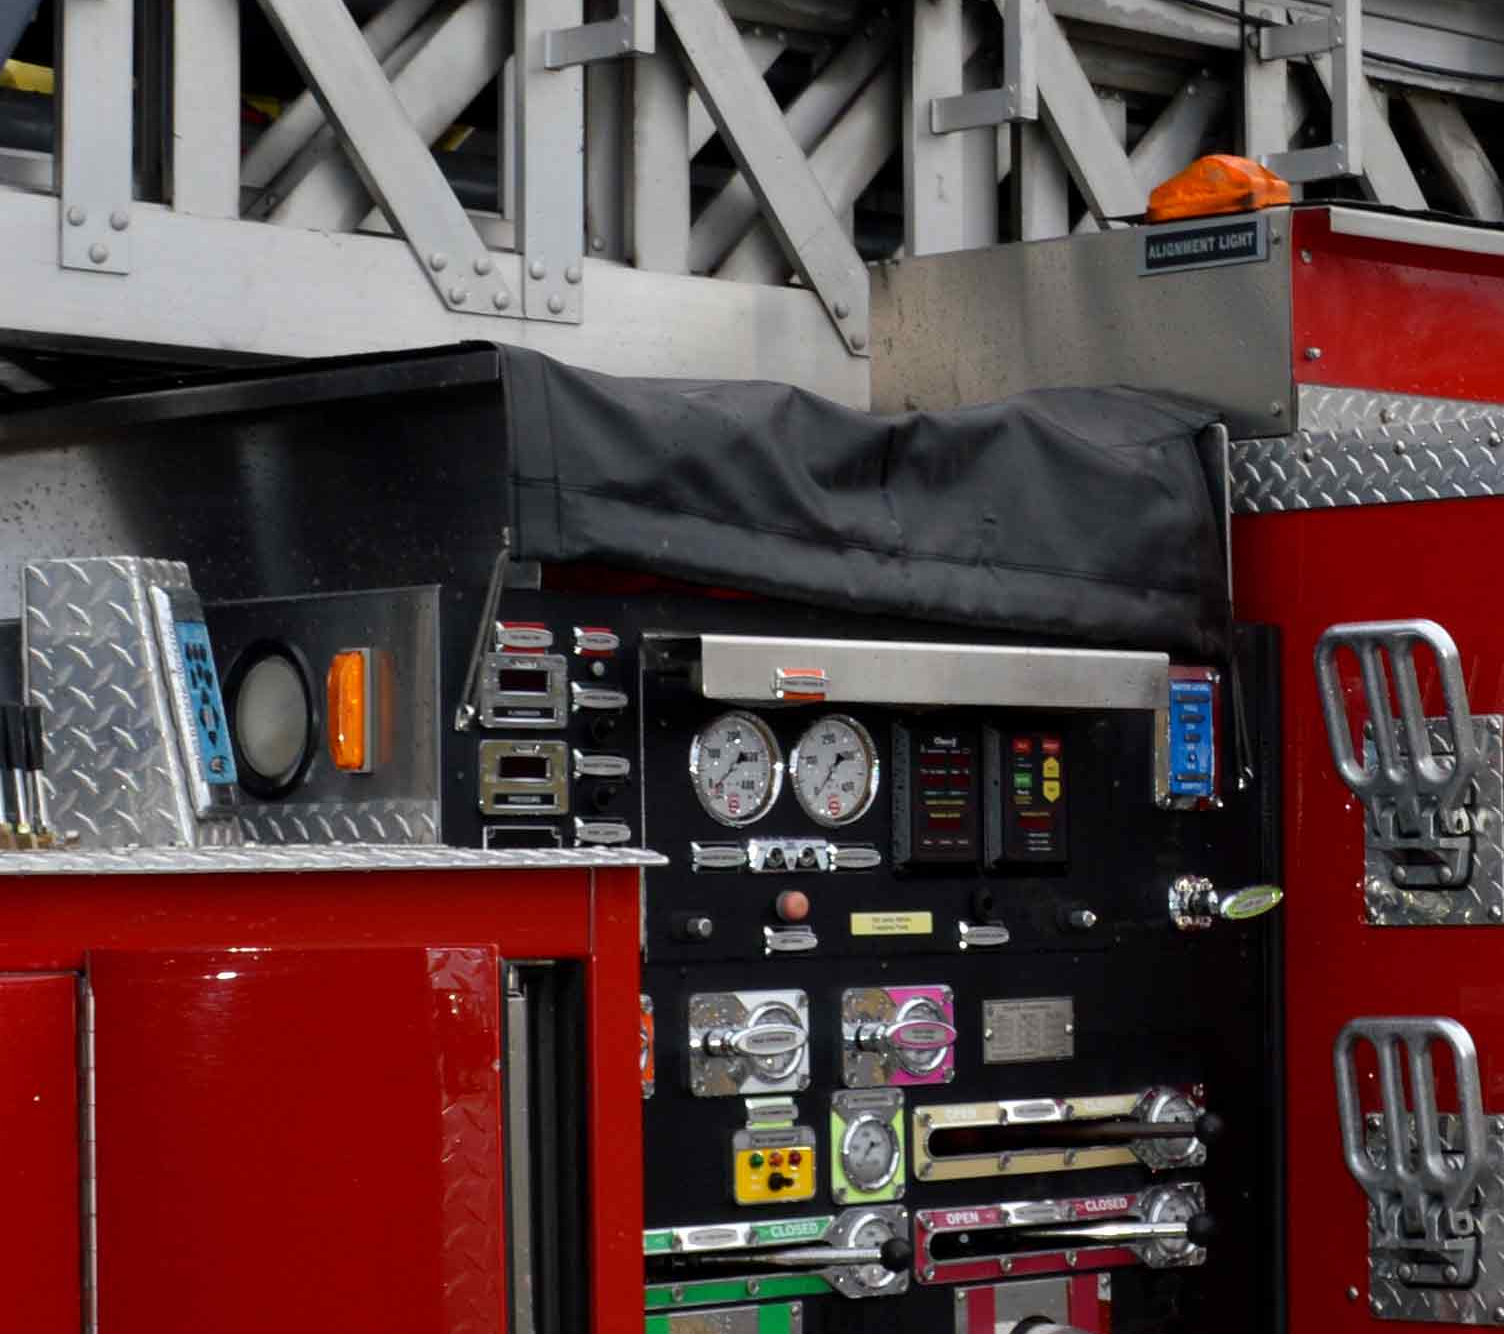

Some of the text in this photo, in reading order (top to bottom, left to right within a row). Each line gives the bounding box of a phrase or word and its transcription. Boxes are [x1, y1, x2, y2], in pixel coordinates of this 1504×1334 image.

[1149, 232, 1254, 259] ALIGNMENT LIGHT
[1084, 1196, 1129, 1213] CLOSED
[946, 1209, 980, 1226] OPEN
[769, 1221, 819, 1239] CLOSED
